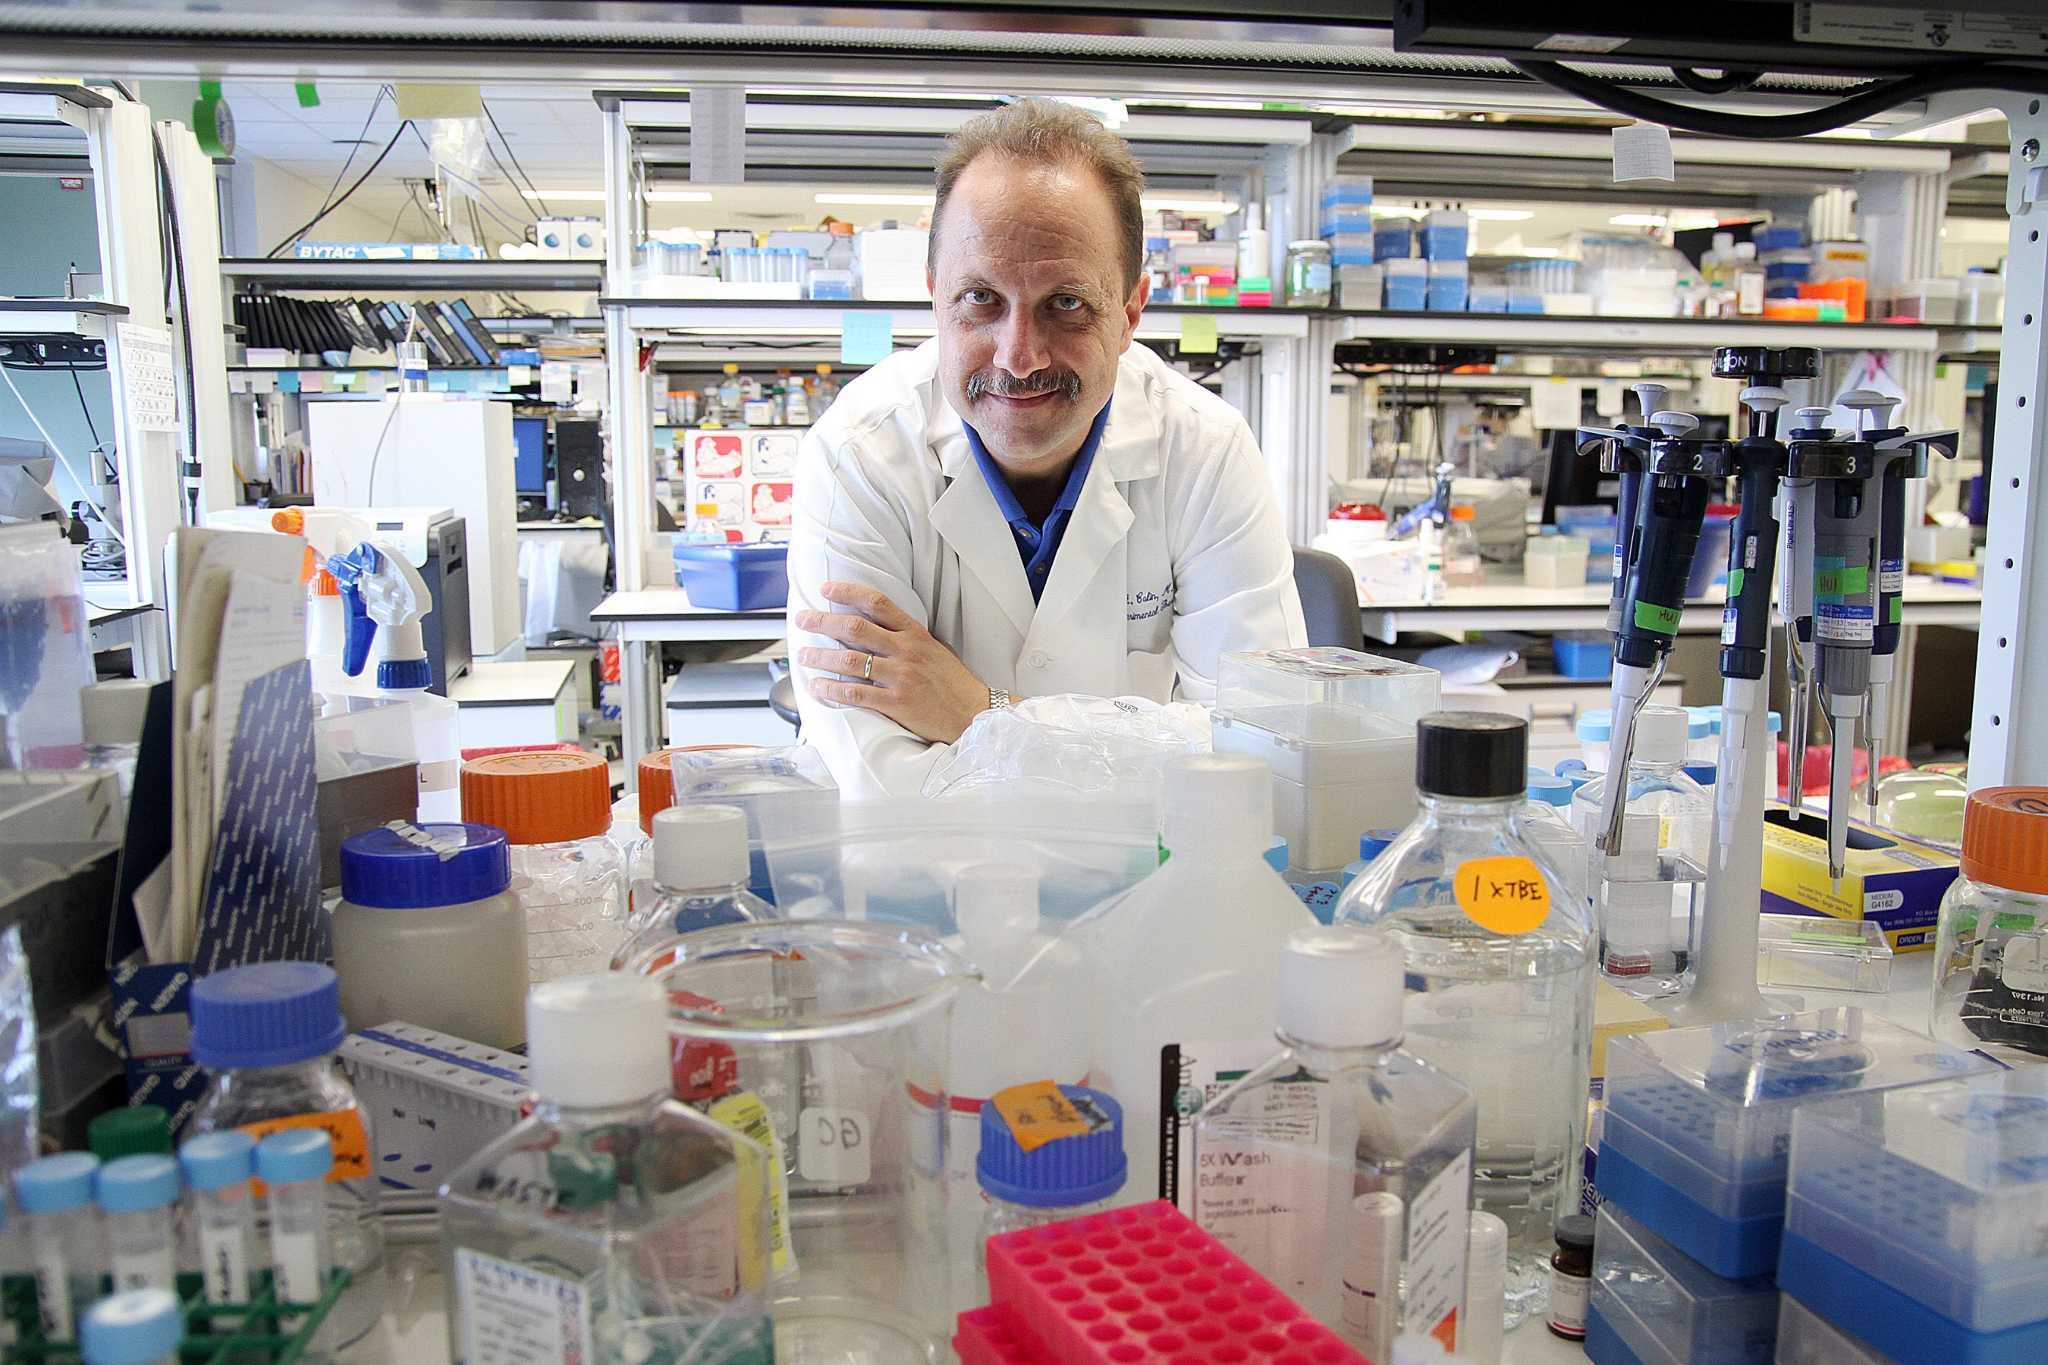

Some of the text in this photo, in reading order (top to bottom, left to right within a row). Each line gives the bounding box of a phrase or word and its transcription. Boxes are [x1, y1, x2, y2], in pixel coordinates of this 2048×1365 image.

[300, 246, 357, 258] BYTAC
[1693, 454, 1703, 470] 2
[1846, 456, 1857, 473] 3
[1871, 900, 1894, 909] G4162
[1219, 1151, 1272, 1167] Wash
[1201, 1172, 1246, 1188] Buffer
